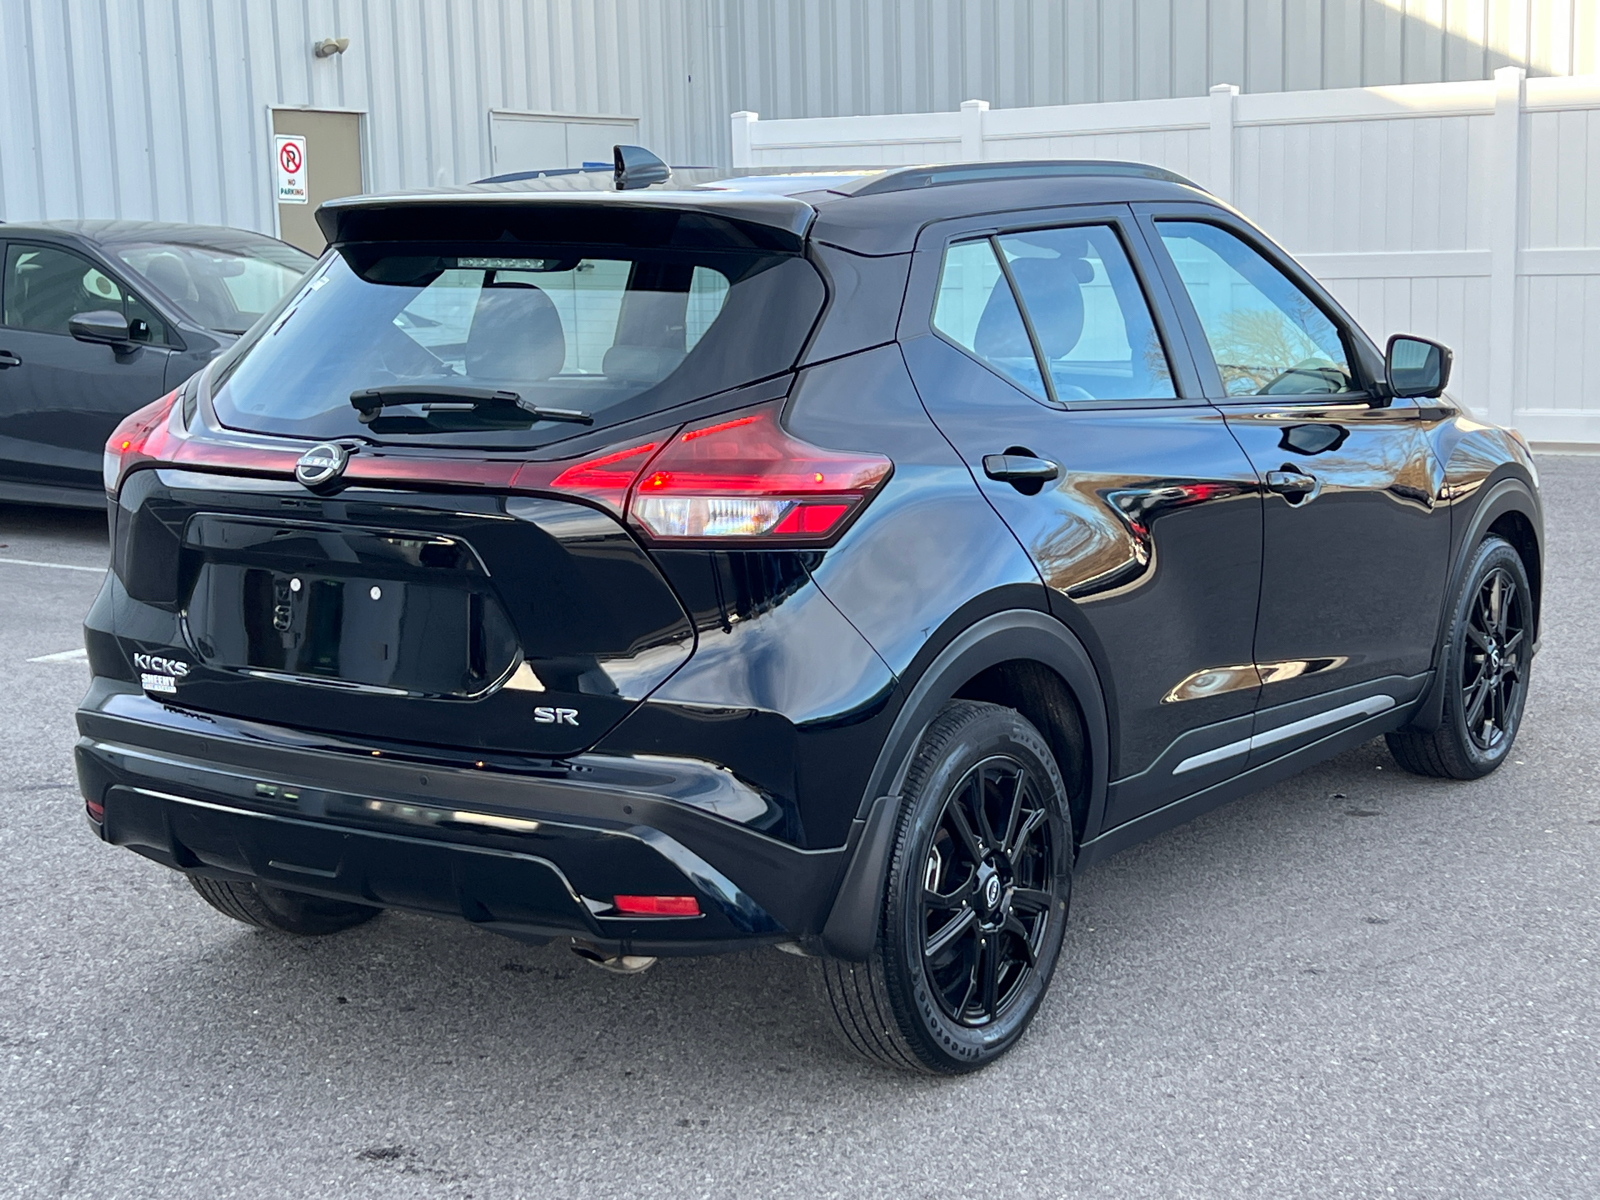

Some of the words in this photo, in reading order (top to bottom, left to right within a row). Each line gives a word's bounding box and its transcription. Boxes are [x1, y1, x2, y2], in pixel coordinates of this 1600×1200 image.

[280, 188, 304, 196] PARKING
[297, 456, 341, 469] NISSAN
[133, 652, 189, 677] KICKS
[534, 707, 579, 726] SR
